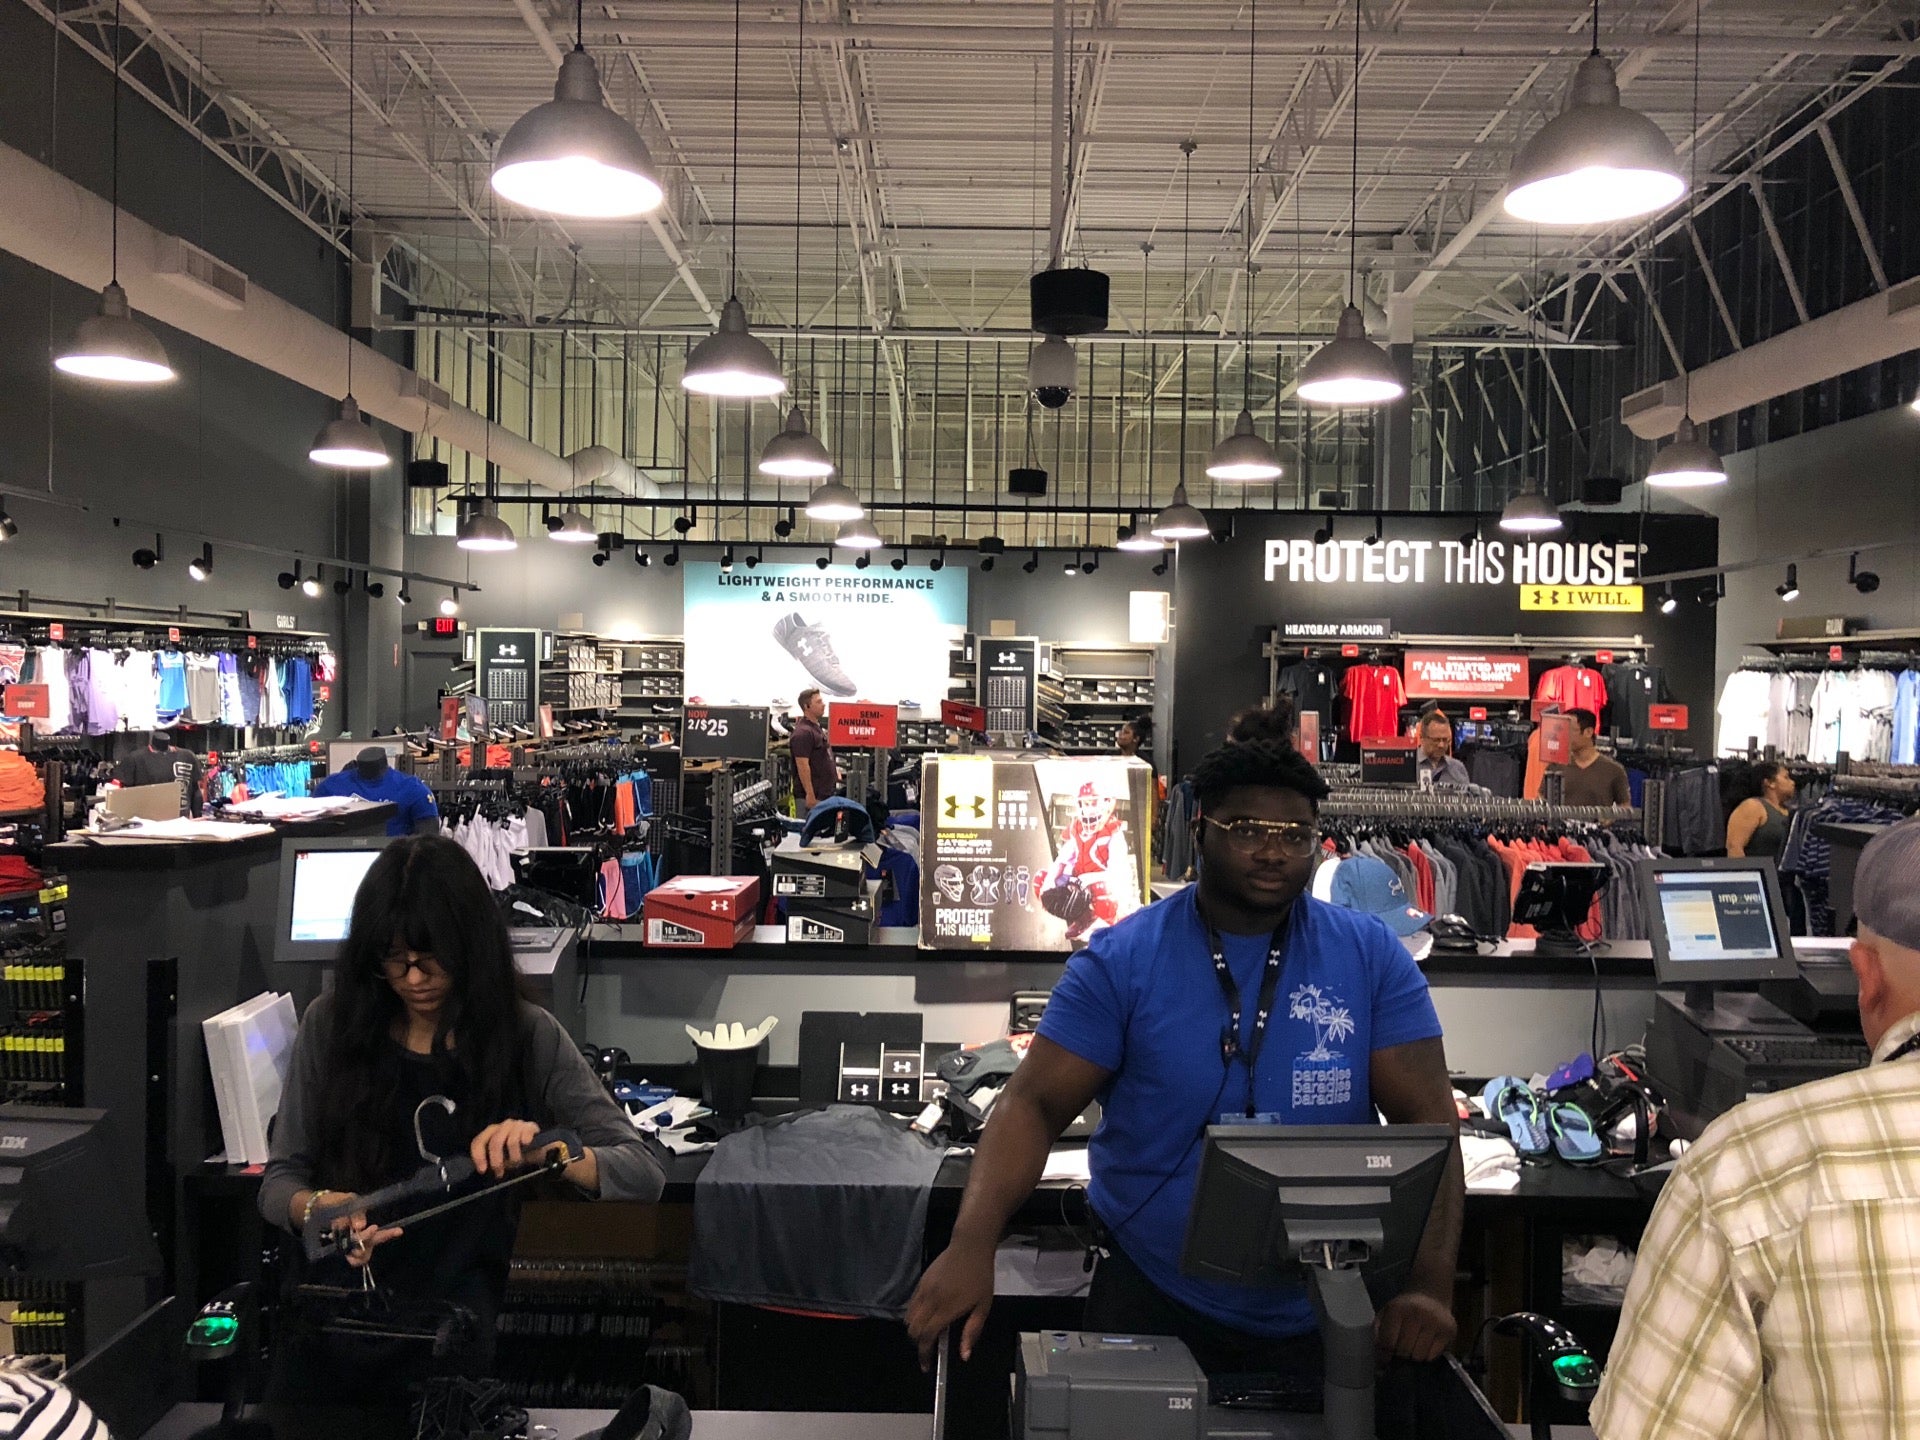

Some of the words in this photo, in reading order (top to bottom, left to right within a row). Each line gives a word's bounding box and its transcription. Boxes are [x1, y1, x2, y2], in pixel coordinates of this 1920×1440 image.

[1264, 539, 1432, 583] PROTECT
[1439, 541, 1505, 584] THIS
[718, 575, 820, 588] LIGHTWEIGHT
[825, 577, 935, 590] PERFORMANCE
[761, 591, 771, 602] &
[775, 591, 785, 602] A
[789, 592, 852, 603] SMOOTH
[856, 593, 894, 604] RIDE.
[1567, 591, 1575, 605] I
[1578, 591, 1631, 606] WILL.
[436, 618, 454, 633] EXIT
[1340, 624, 1384, 636] ARMOUR
[1445, 662, 1492, 672] STARTED
[1493, 663, 1521, 673] WITH
[688, 710, 708, 718] NOW
[860, 711, 885, 719] SEMI-
[687, 718, 729, 737] 2/$25
[838, 718, 872, 727] ANNUAL
[849, 726, 876, 736] EVENT
[1364, 757, 1405, 765] CLEARANCE
[975, 847, 993, 856] KIT
[935, 908, 994, 924] PROTECT
[935, 923, 957, 937] THIS
[1292, 1067, 1351, 1083] paradise
[1292, 1079, 1351, 1095] paradise
[1292, 1091, 1351, 1108] paradise
[1366, 1155, 1392, 1168] IBM
[1169, 1397, 1193, 1409] IBM
